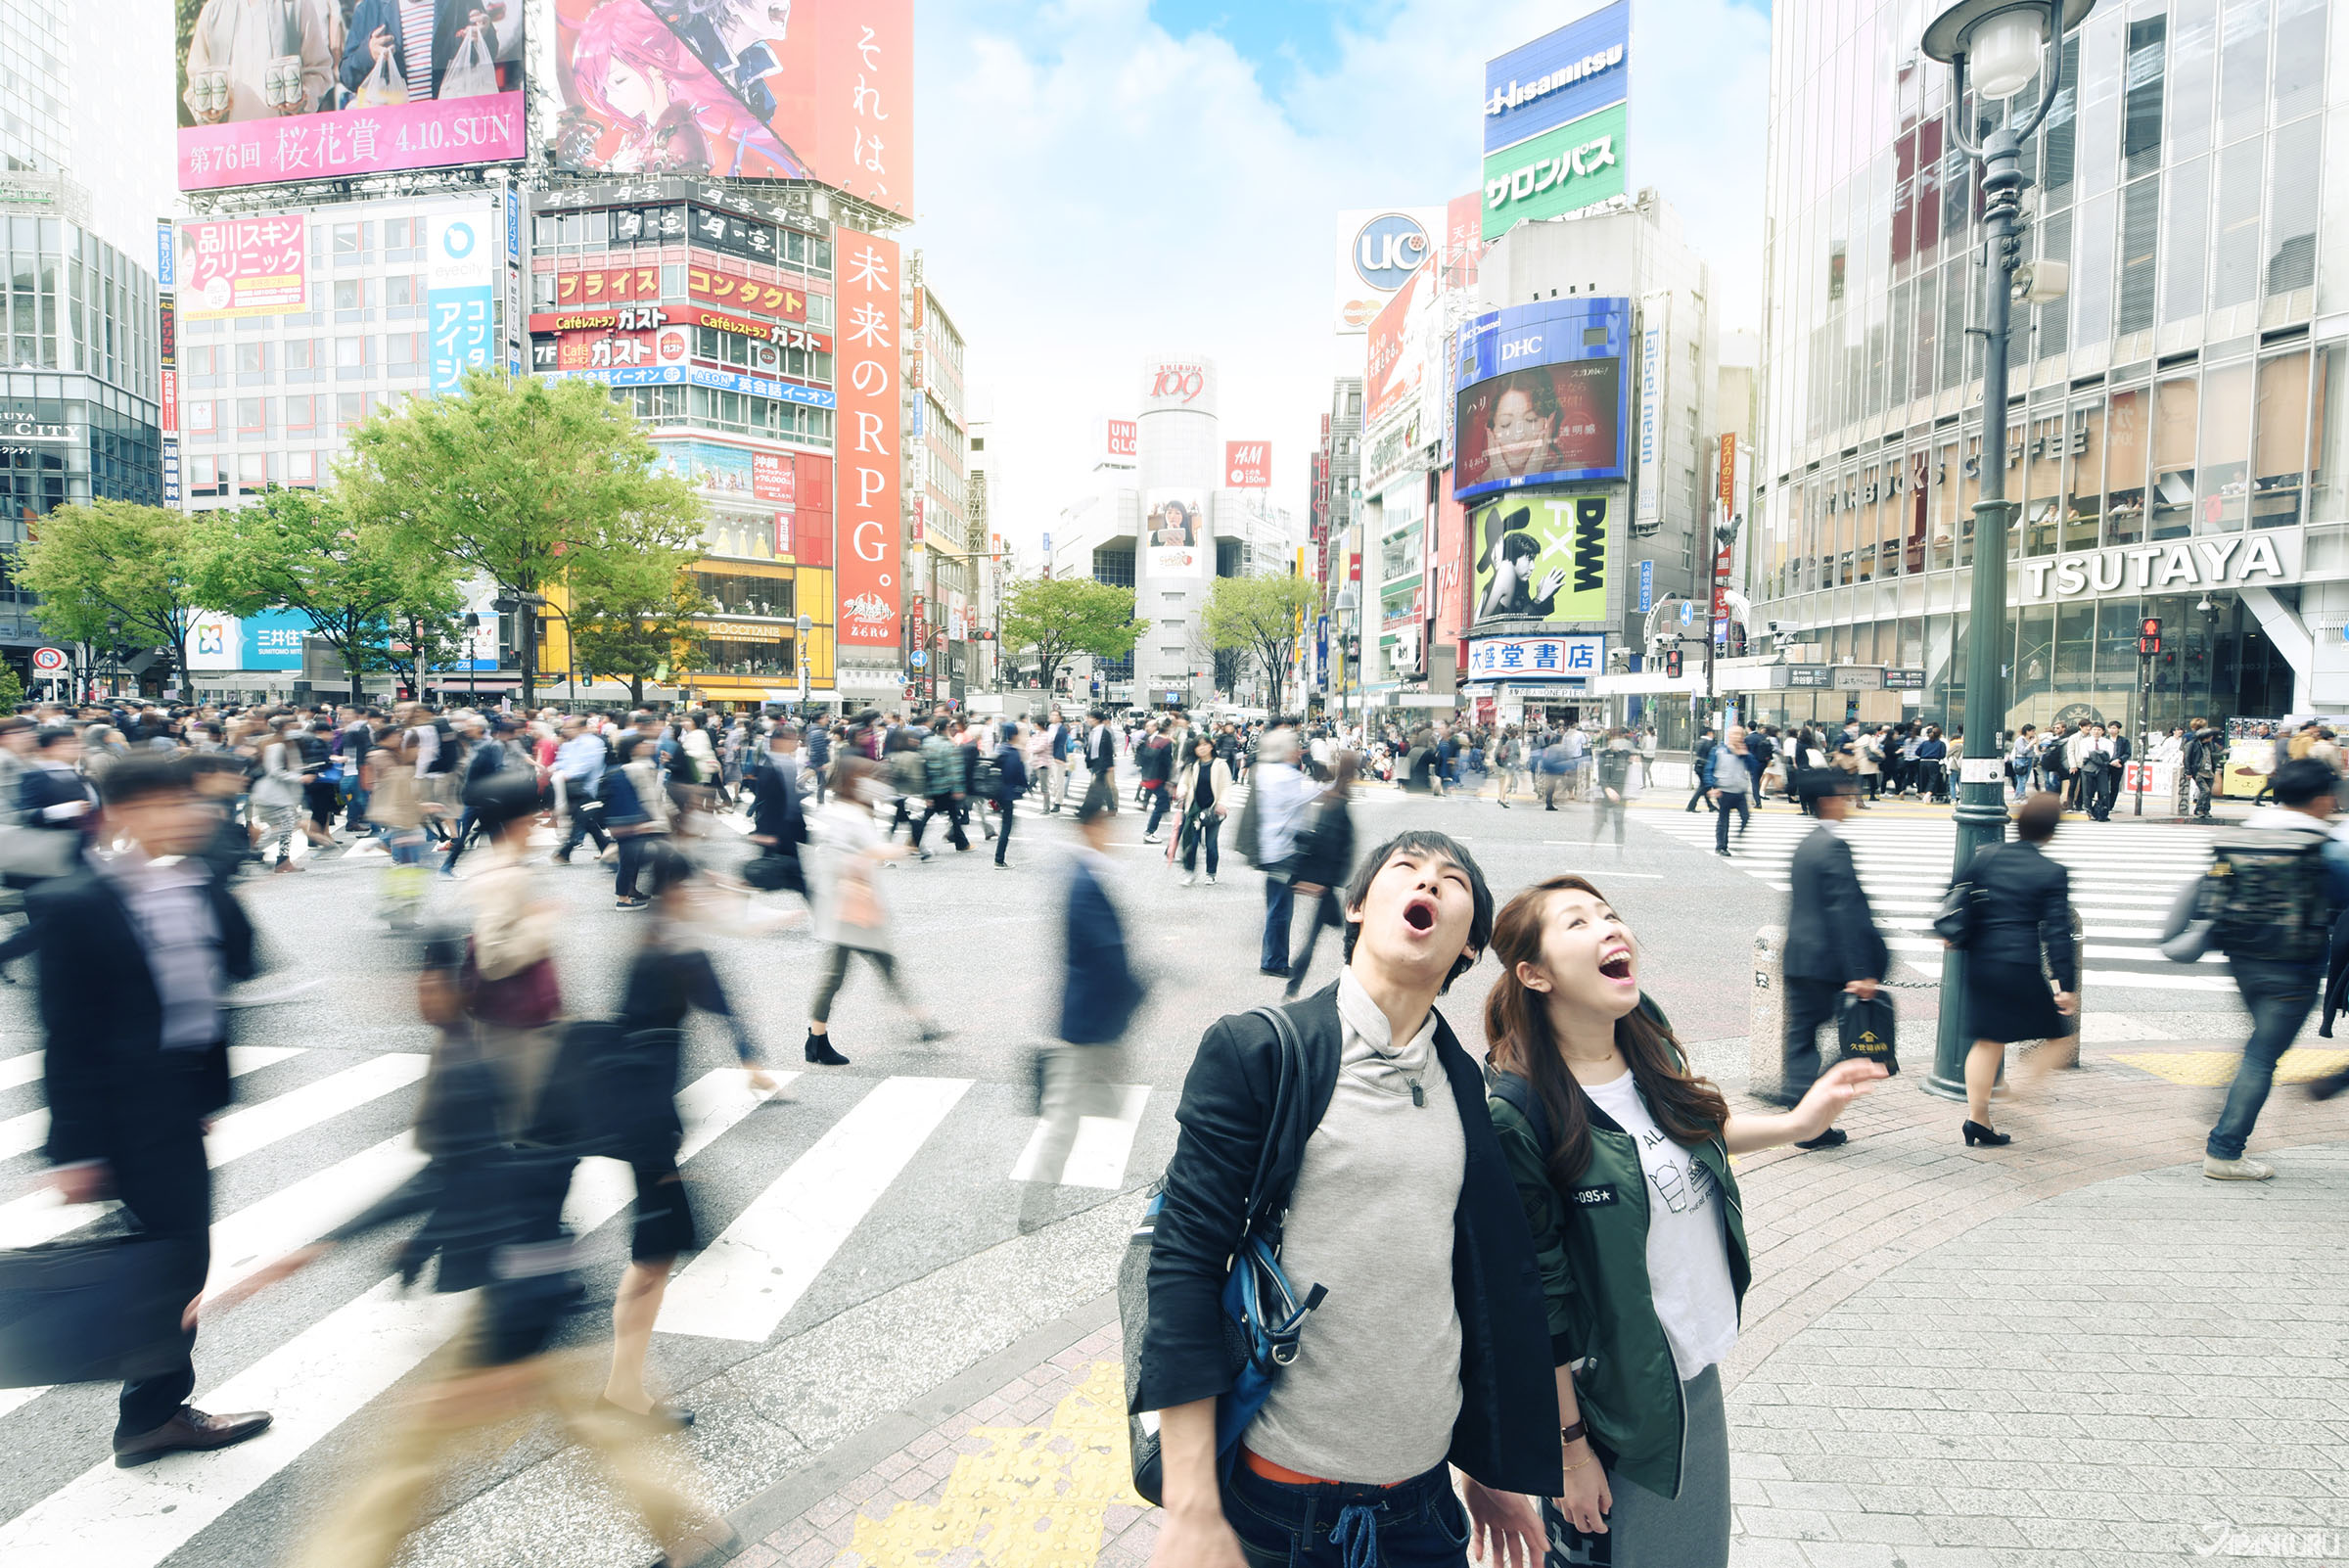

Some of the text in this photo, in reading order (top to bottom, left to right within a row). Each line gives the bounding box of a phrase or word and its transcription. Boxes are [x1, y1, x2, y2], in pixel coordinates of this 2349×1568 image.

[1484, 43, 1623, 115] Hisamitsu
[853, 24, 890, 196] それは、
[189, 114, 511, 174] 第76回 桜花賞 4.10.SUN
[1485, 135, 1615, 209] サロンパス
[198, 221, 301, 254] 品川スキン
[200, 248, 301, 280] クリニック
[436, 262, 484, 278] eyecity
[559, 270, 657, 299] プライス
[689, 269, 803, 314] コンタクト
[618, 307, 668, 331] ガスト
[591, 338, 651, 368] ガスト
[770, 325, 822, 352] ガスト
[1501, 337, 1543, 361] DHC
[534, 346, 557, 363] 7F
[1159, 363, 1203, 373] SHIBUYA
[696, 370, 834, 405] AEON 英会話イーオン
[1150, 370, 1204, 404] 109
[15, 423, 79, 437] CITY
[847, 245, 893, 586] 未来のRPG。
[1111, 423, 1135, 438] UNI
[1234, 445, 1264, 465] H&M
[1543, 500, 1575, 562] FX
[1574, 498, 1606, 592] DMM
[2025, 535, 2282, 598] TSUTAYA
[709, 622, 781, 637] L'OCCITANE
[851, 624, 890, 638] ZERO
[1472, 643, 1595, 671] 大盛堂書店
